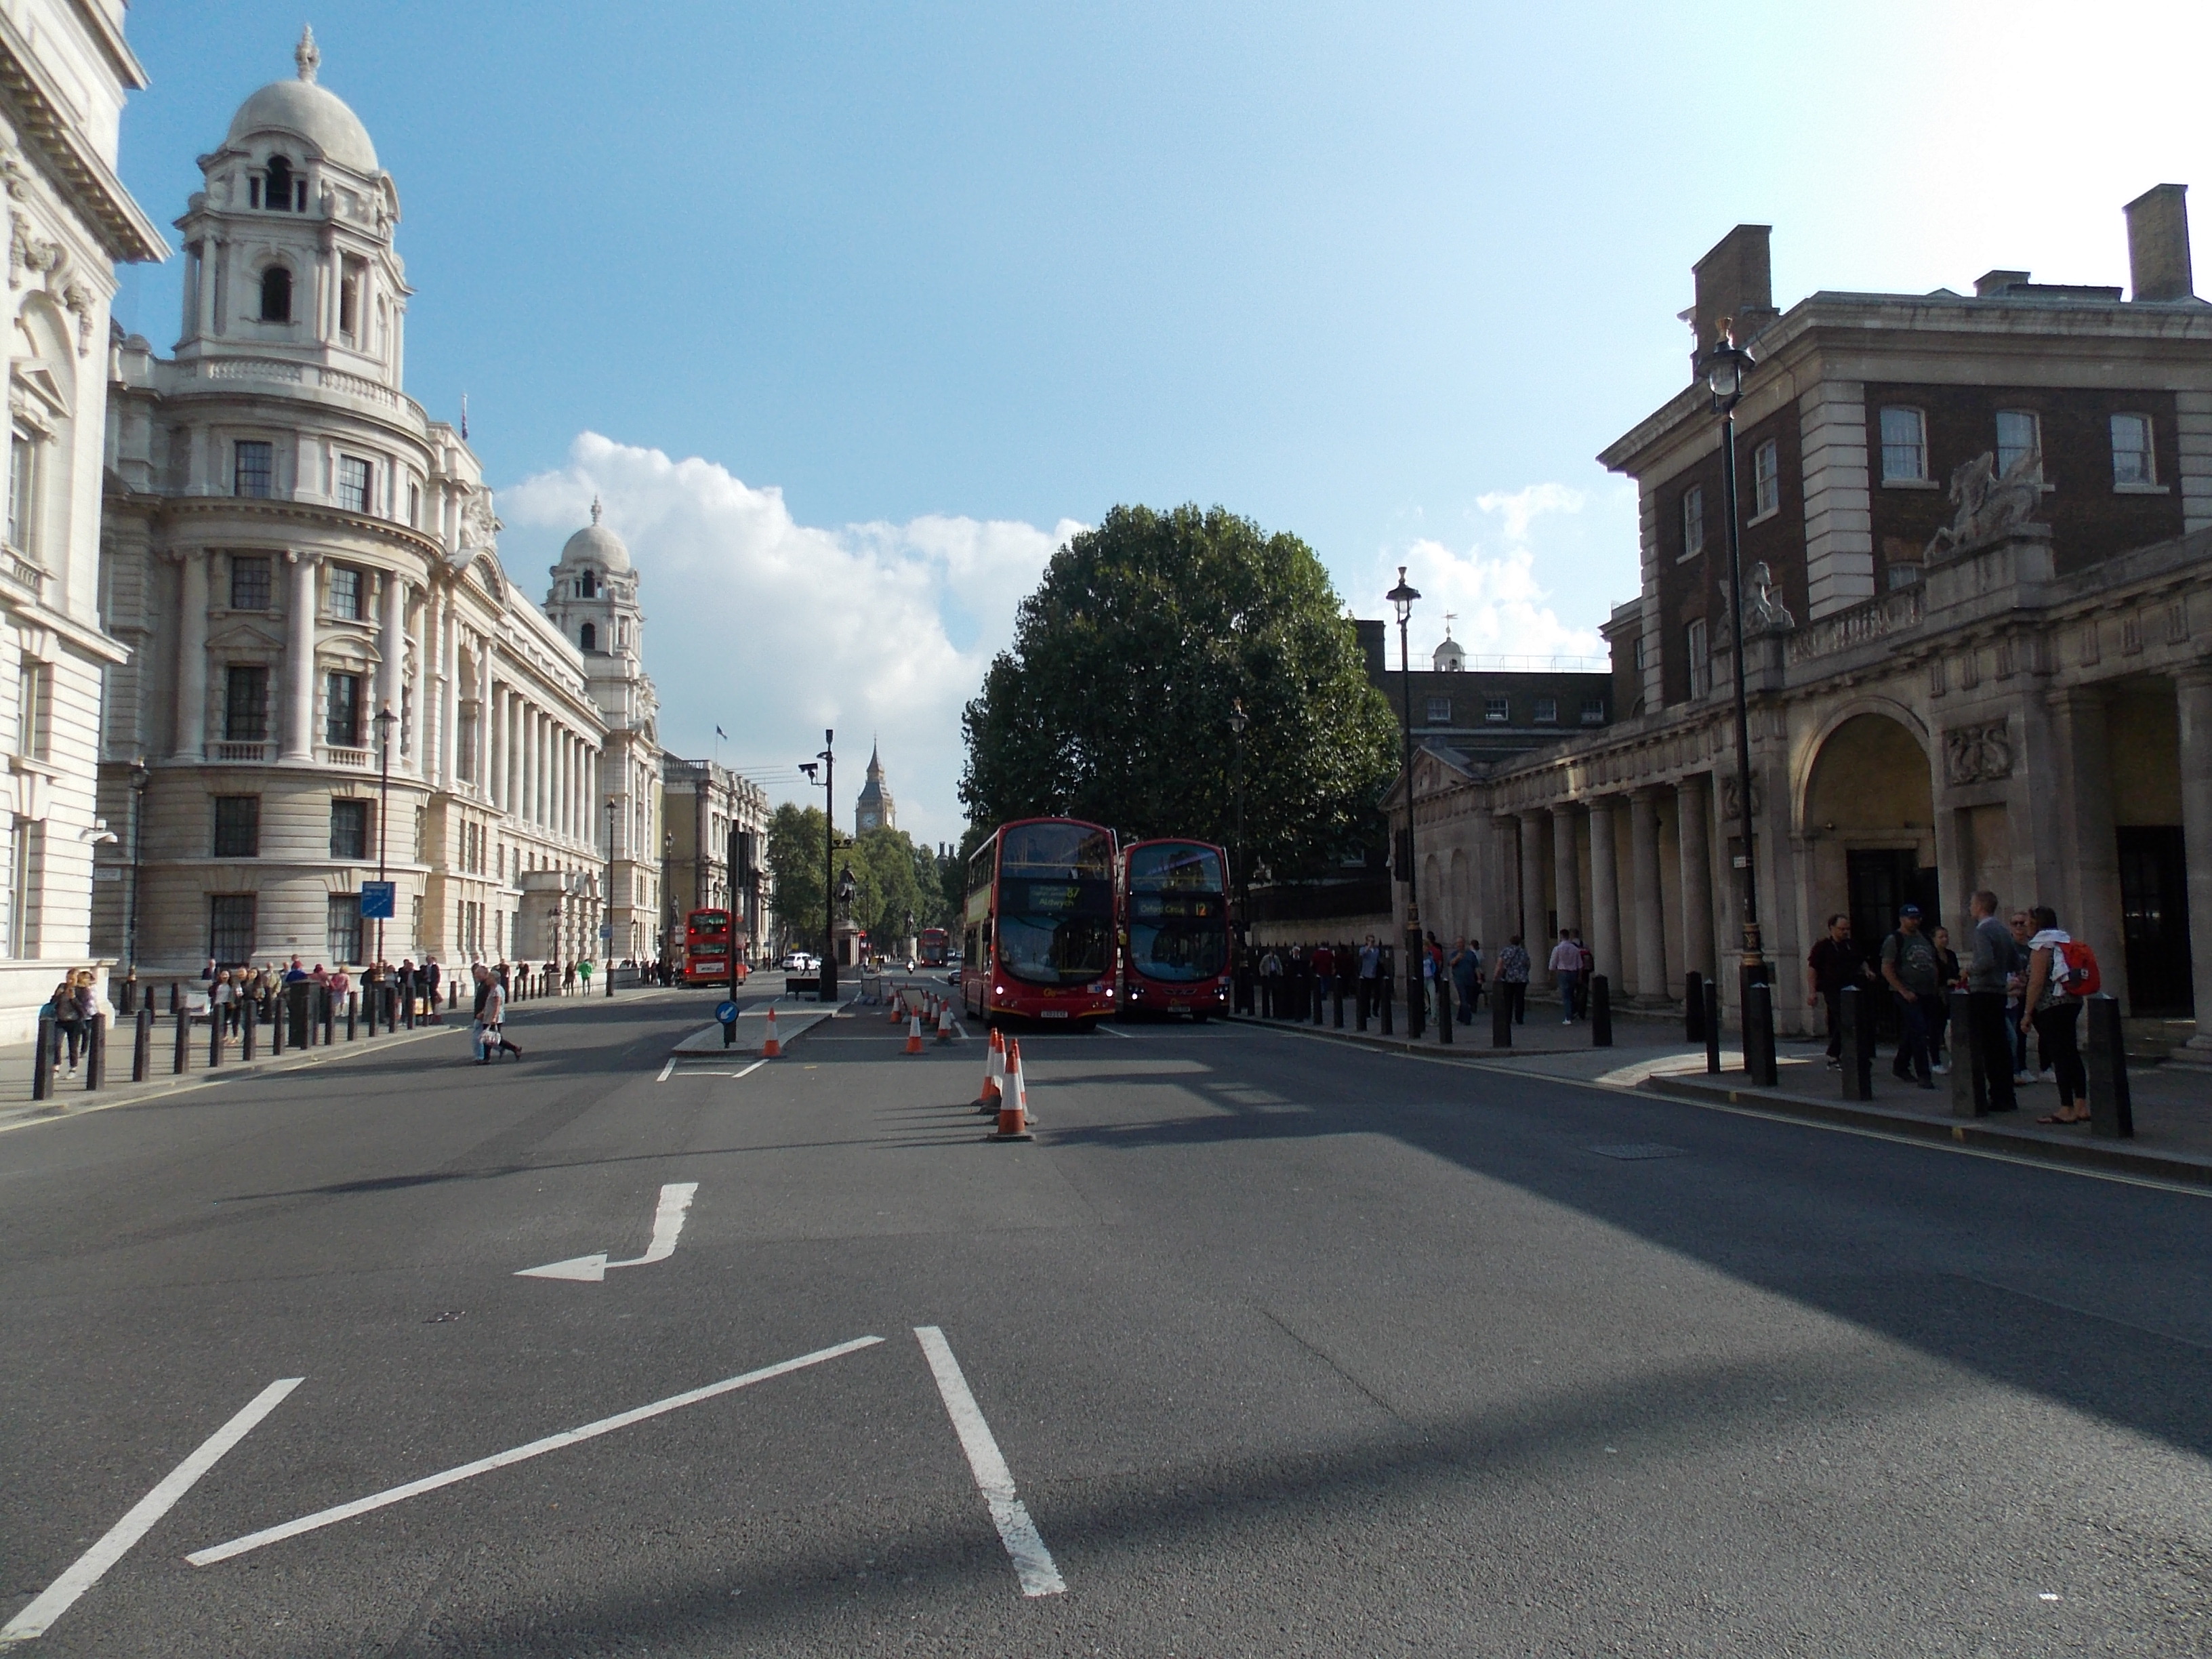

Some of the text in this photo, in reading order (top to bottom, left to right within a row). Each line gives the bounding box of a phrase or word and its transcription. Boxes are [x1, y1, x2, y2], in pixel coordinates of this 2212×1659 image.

[1067, 886, 1080, 898] 87
[1039, 899, 1073, 910] Aldwych
[1140, 904, 1164, 913] Oxford
[1195, 903, 1206, 916] 12
